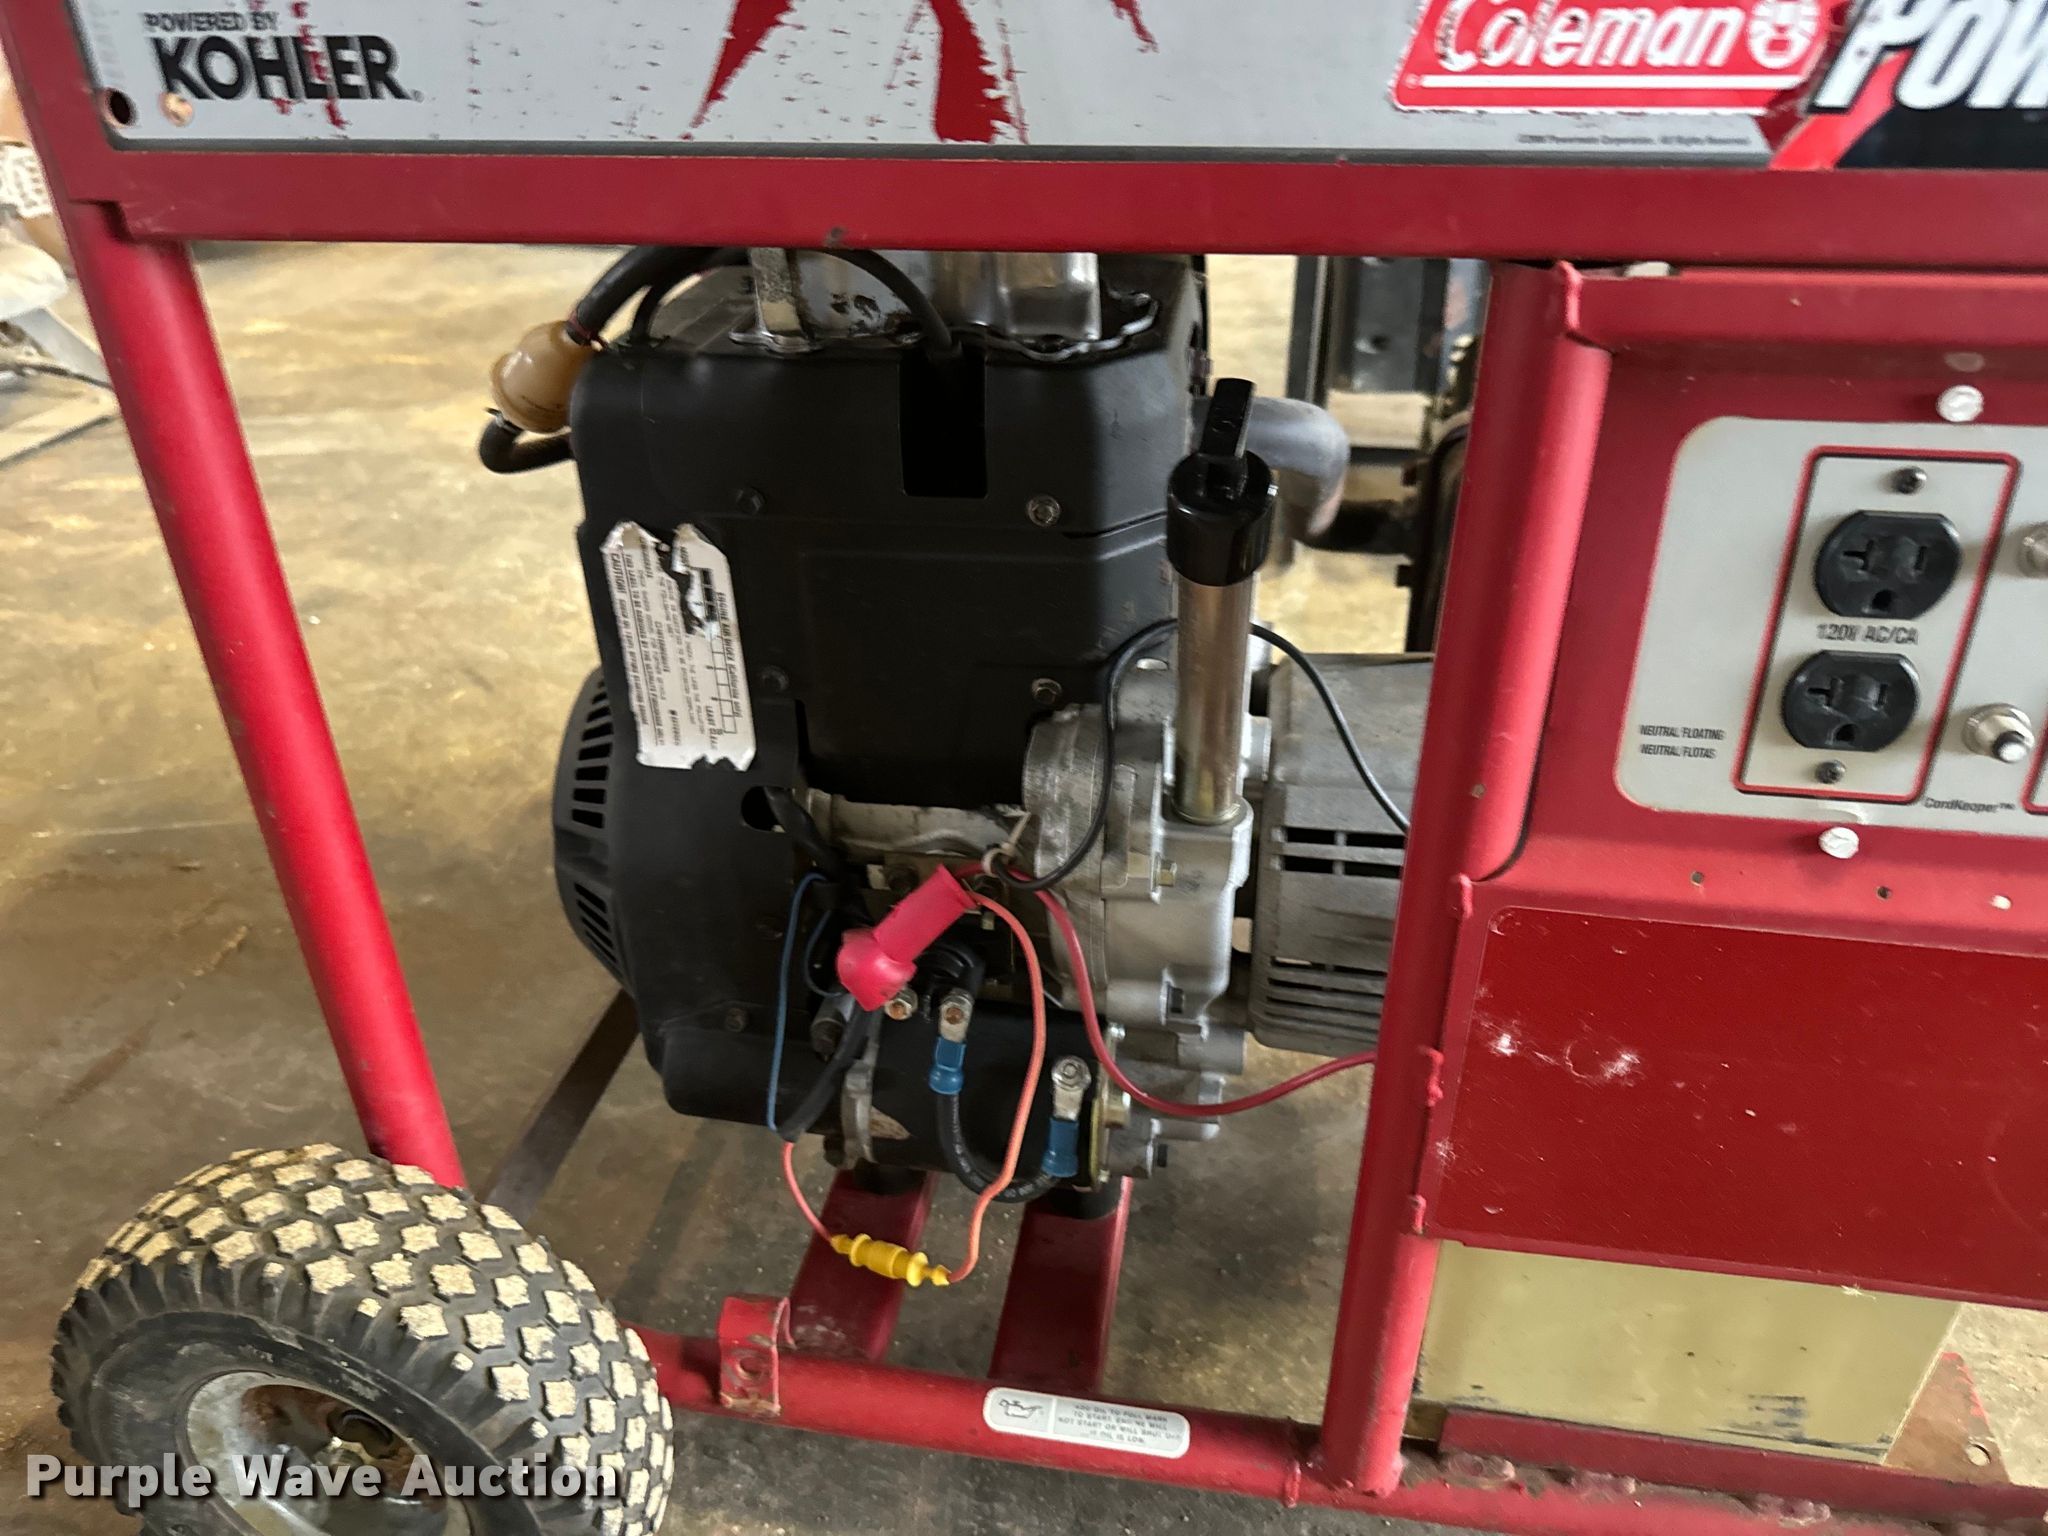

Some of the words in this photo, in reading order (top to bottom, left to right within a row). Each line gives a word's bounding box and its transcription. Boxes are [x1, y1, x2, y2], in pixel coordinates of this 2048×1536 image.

[144, 12, 247, 32] POWERED
[252, 12, 279, 31] BY
[1434, 0, 1747, 72] Coleman
[148, 35, 413, 100] KOHLER
[610, 553, 627, 593] CAUTION!
[1817, 624, 1858, 641] 120V
[1864, 625, 1918, 644] AC/CA
[1639, 725, 1680, 738] NEUTRAL
[1682, 727, 1725, 741] FLOATING
[1640, 744, 1680, 757] NEUTRAL
